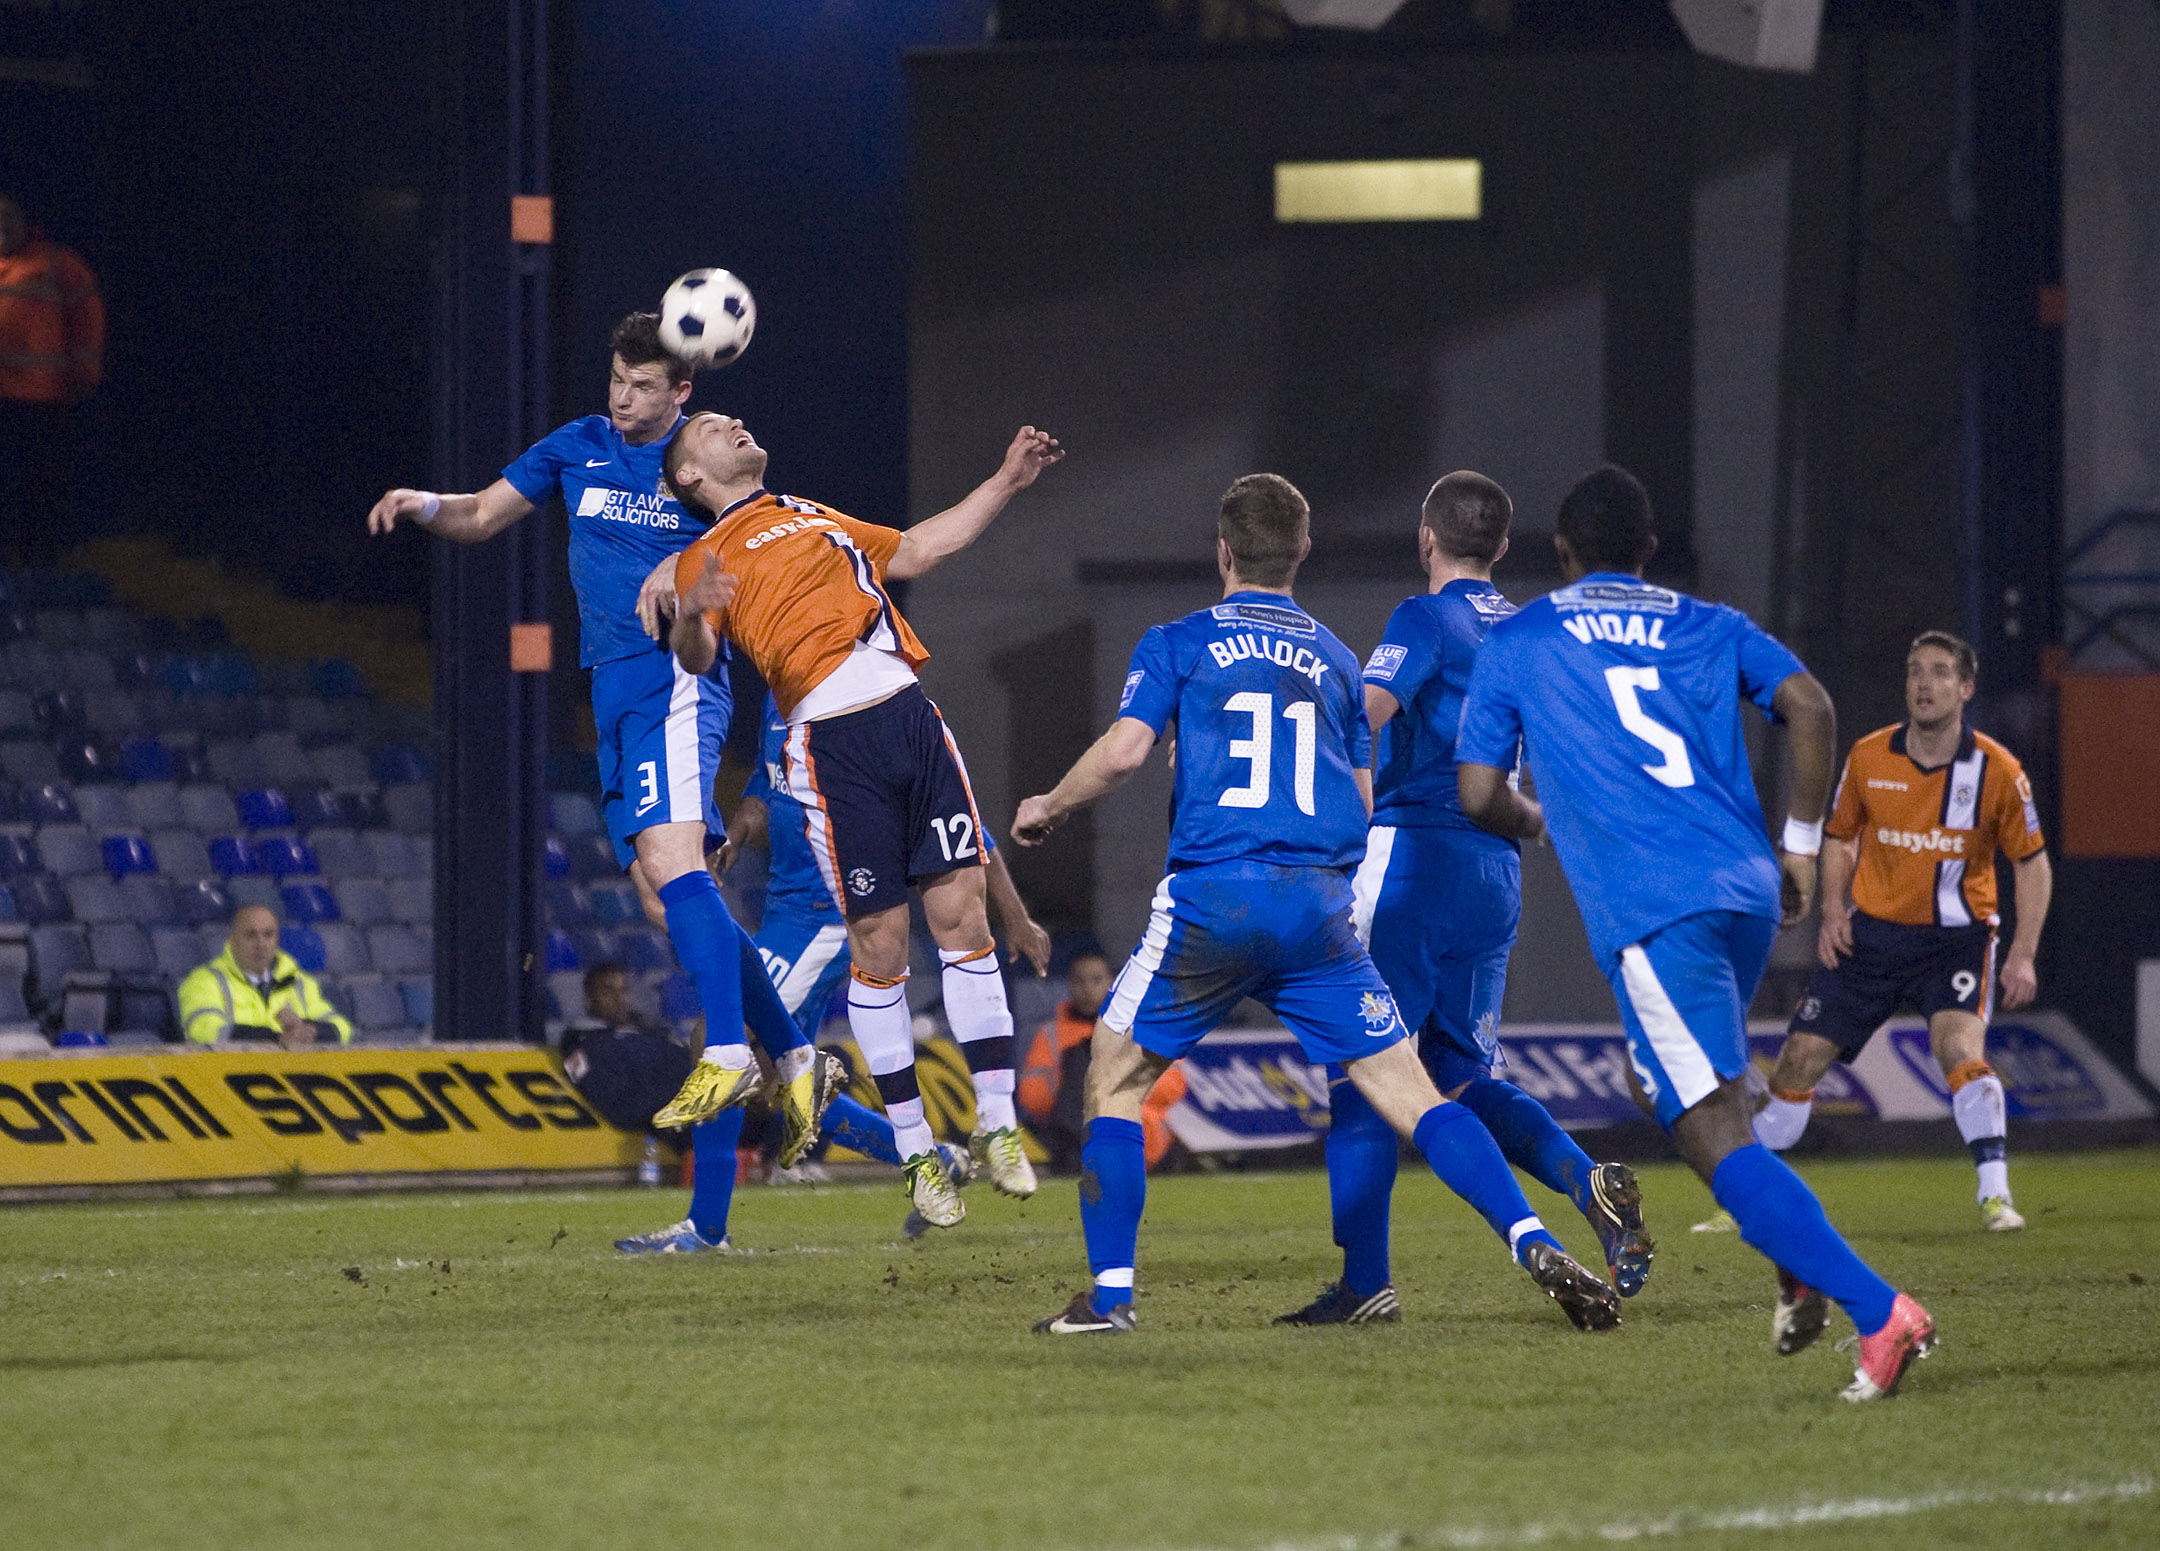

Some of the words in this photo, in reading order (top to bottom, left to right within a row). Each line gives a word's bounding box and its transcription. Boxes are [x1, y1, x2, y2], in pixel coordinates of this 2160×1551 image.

[602, 505, 680, 530] SOLICITORS
[1275, 614, 1309, 625] Hospice
[1562, 613, 1667, 651] VIDAL
[1208, 633, 1330, 687] BULLOCK
[1603, 665, 1696, 788] 5
[1217, 691, 1316, 817] 31
[637, 760, 658, 806] 3
[930, 812, 978, 861] 12
[1877, 827, 1966, 854] easyJet
[1951, 969, 1977, 1003] 9
[223, 1061, 601, 1145] sports
